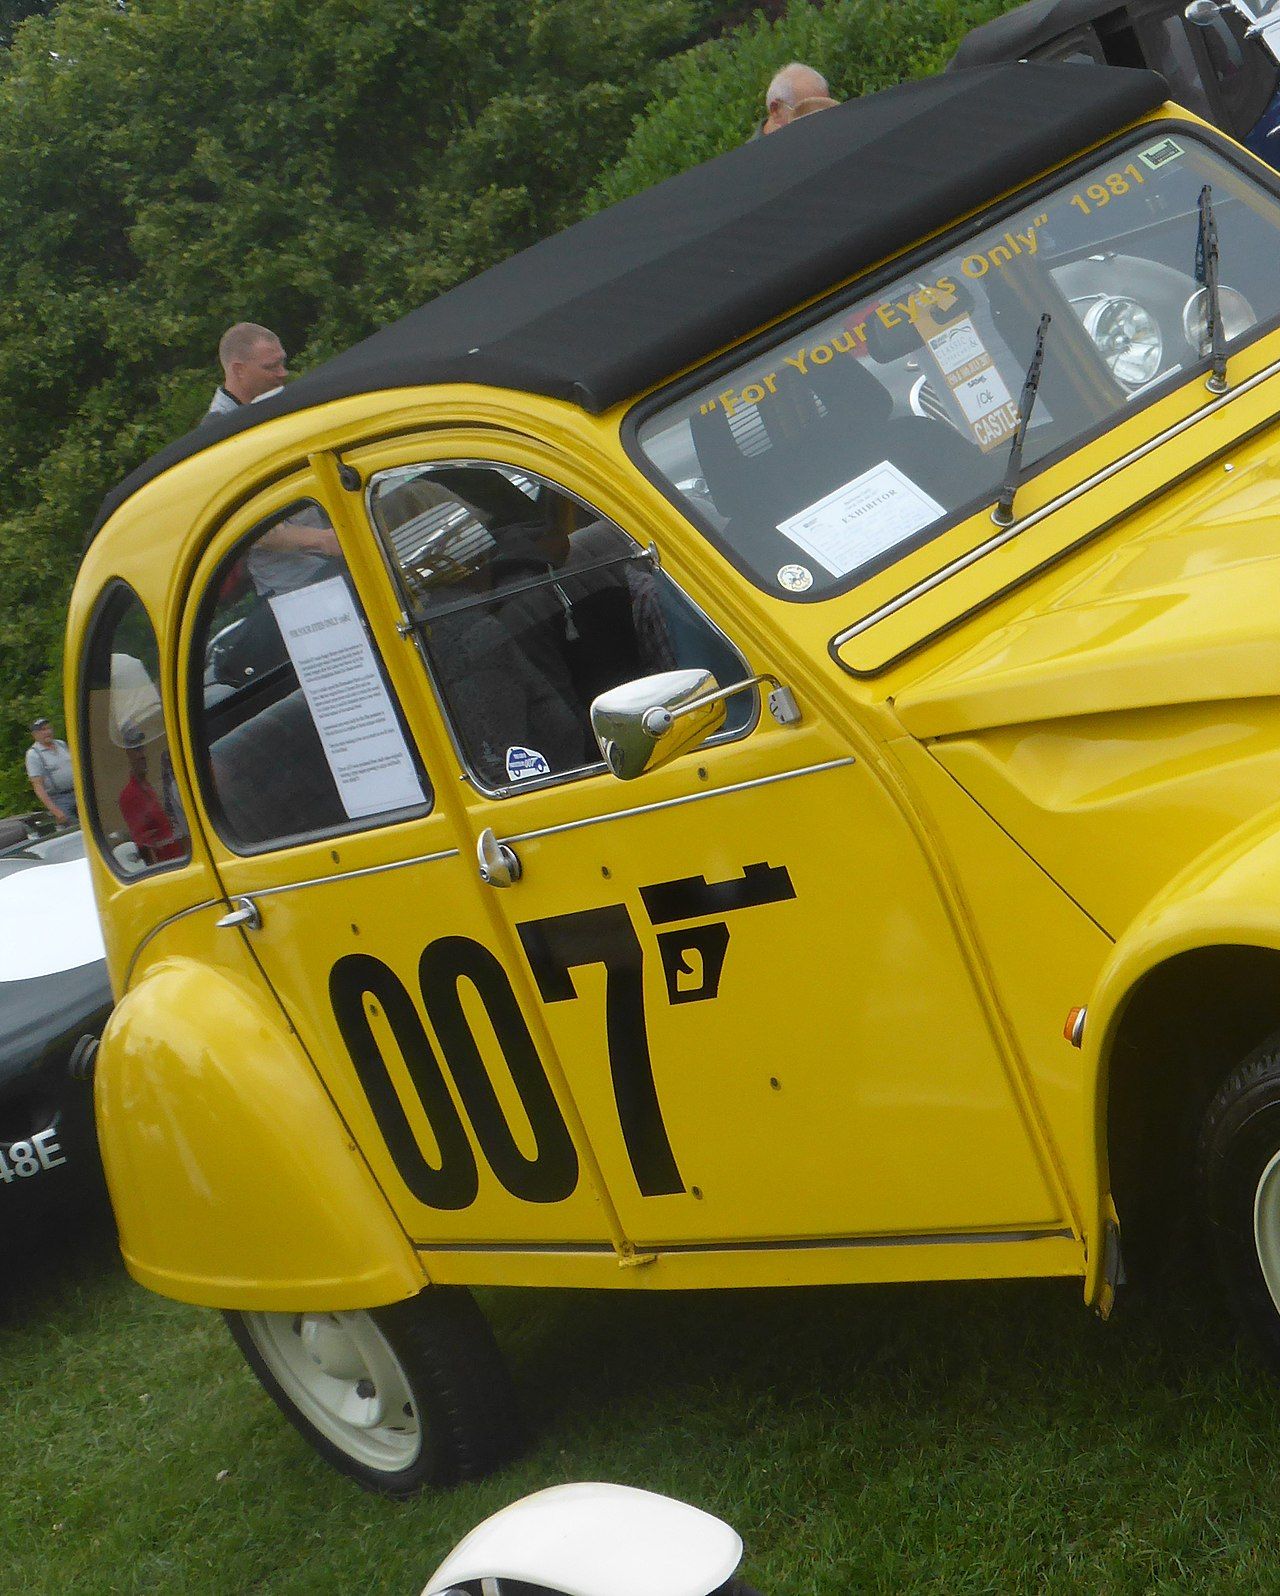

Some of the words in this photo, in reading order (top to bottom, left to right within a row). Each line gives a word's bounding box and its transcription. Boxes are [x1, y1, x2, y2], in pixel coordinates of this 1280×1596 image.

[783, 321, 868, 376] Your
[874, 276, 957, 330] Eyes
[1069, 163, 1146, 216] 1981
[974, 401, 1022, 445] CASTLE
[841, 488, 899, 524] EXHIBITOR
[328, 902, 687, 1211] 007
